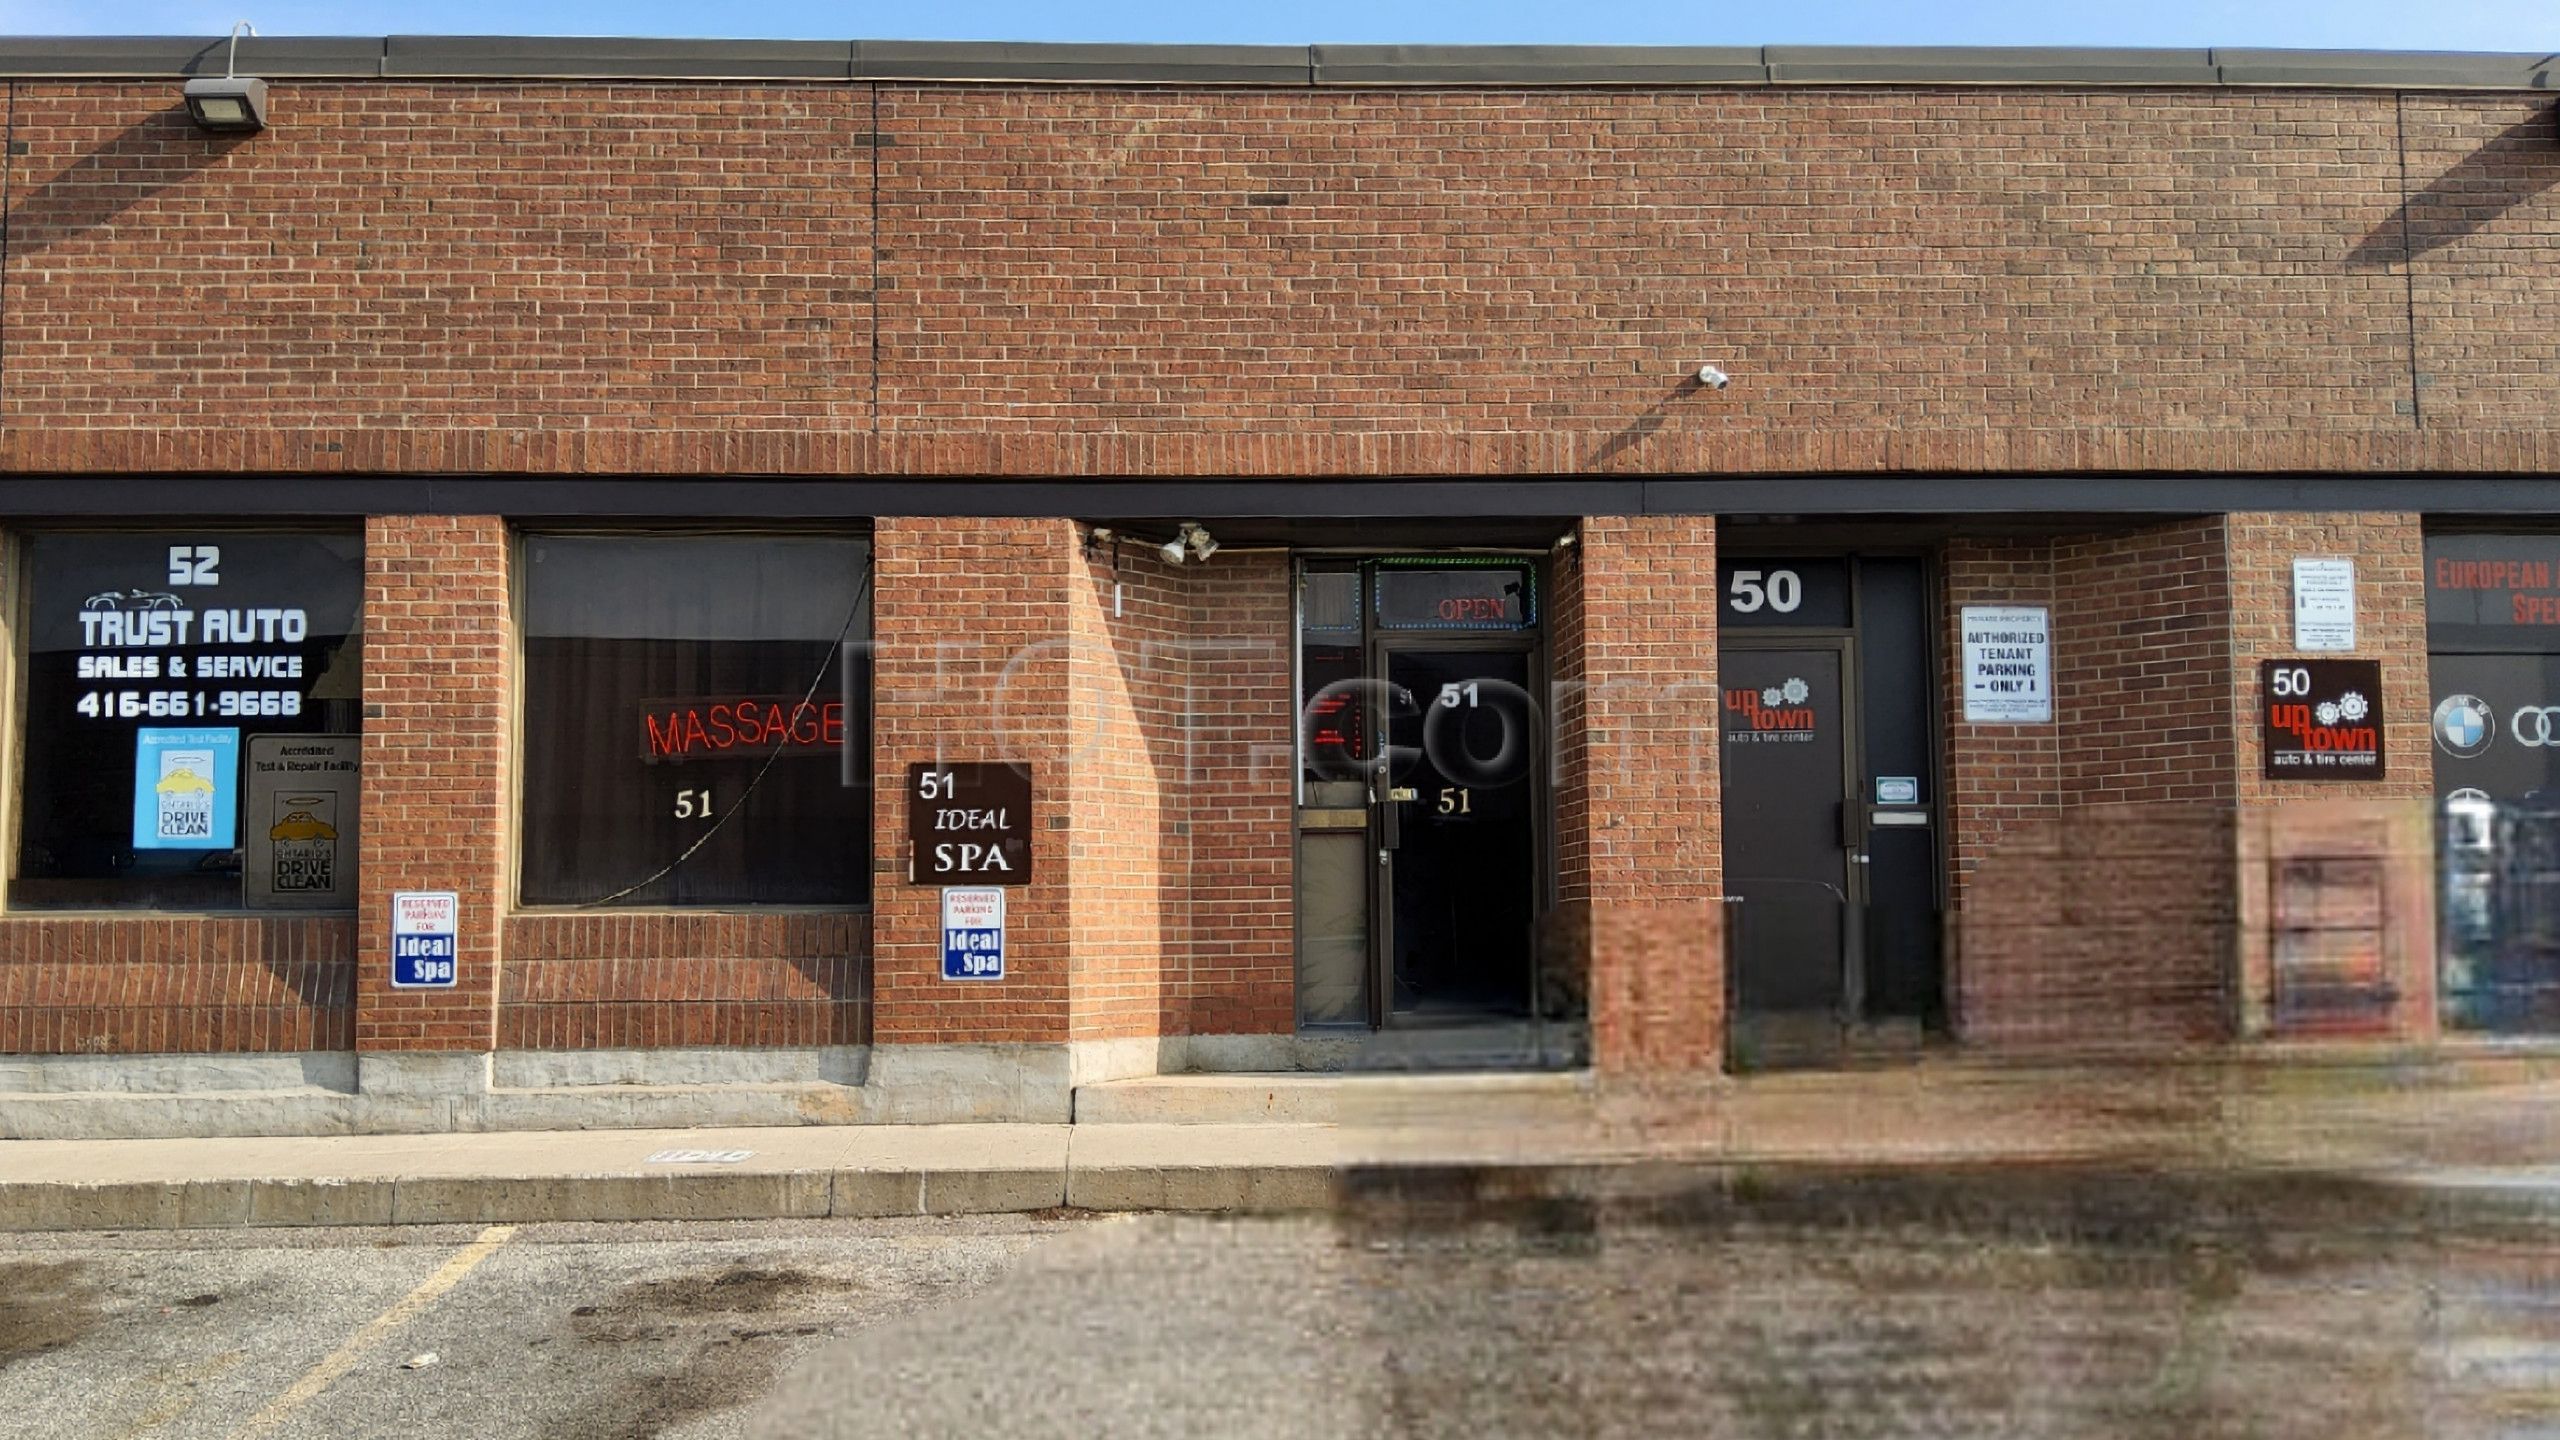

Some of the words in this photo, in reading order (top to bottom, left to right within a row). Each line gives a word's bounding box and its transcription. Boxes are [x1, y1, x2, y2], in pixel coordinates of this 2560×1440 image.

[169, 546, 219, 585] 52
[2435, 557, 2549, 589] EUROPEAN
[1731, 570, 1801, 613] 50
[1439, 598, 1505, 620] OPEN
[79, 610, 194, 646] TRUST
[204, 609, 308, 643] AUTO
[1968, 632, 2044, 643] AUTHORIZED
[1980, 648, 2033, 660] TENANT
[77, 656, 160, 678] SALES
[168, 656, 187, 677] &
[197, 656, 302, 678] SERVICE
[1978, 664, 2035, 676] PARKING
[1990, 680, 2023, 692] ONLY
[2273, 668, 2310, 696] 50
[1441, 683, 1478, 708] 51
[648, 702, 845, 756] MASSAGE
[2272, 704, 2310, 736] up
[2302, 726, 2376, 751] town
[256, 761, 275, 772] Test
[287, 761, 321, 774] Repair
[323, 761, 359, 773] Facility
[2274, 754, 2300, 765] auto
[2304, 753, 2313, 765] &
[2317, 754, 2336, 765] tire
[2340, 755, 2376, 765] center
[919, 772, 954, 799] 51
[674, 789, 713, 819] 51
[1437, 787, 1472, 814] 51
[162, 811, 208, 824] DRIVE
[934, 807, 1012, 830] IDEAL
[161, 824, 208, 835] CLEAN
[277, 860, 331, 875] DRIVE
[934, 843, 1014, 872] SPA
[277, 875, 330, 889] CLEAN
[397, 937, 451, 956] Ideal
[948, 930, 999, 950] Ideal
[414, 960, 451, 982] Spa
[963, 952, 999, 975] Spa
